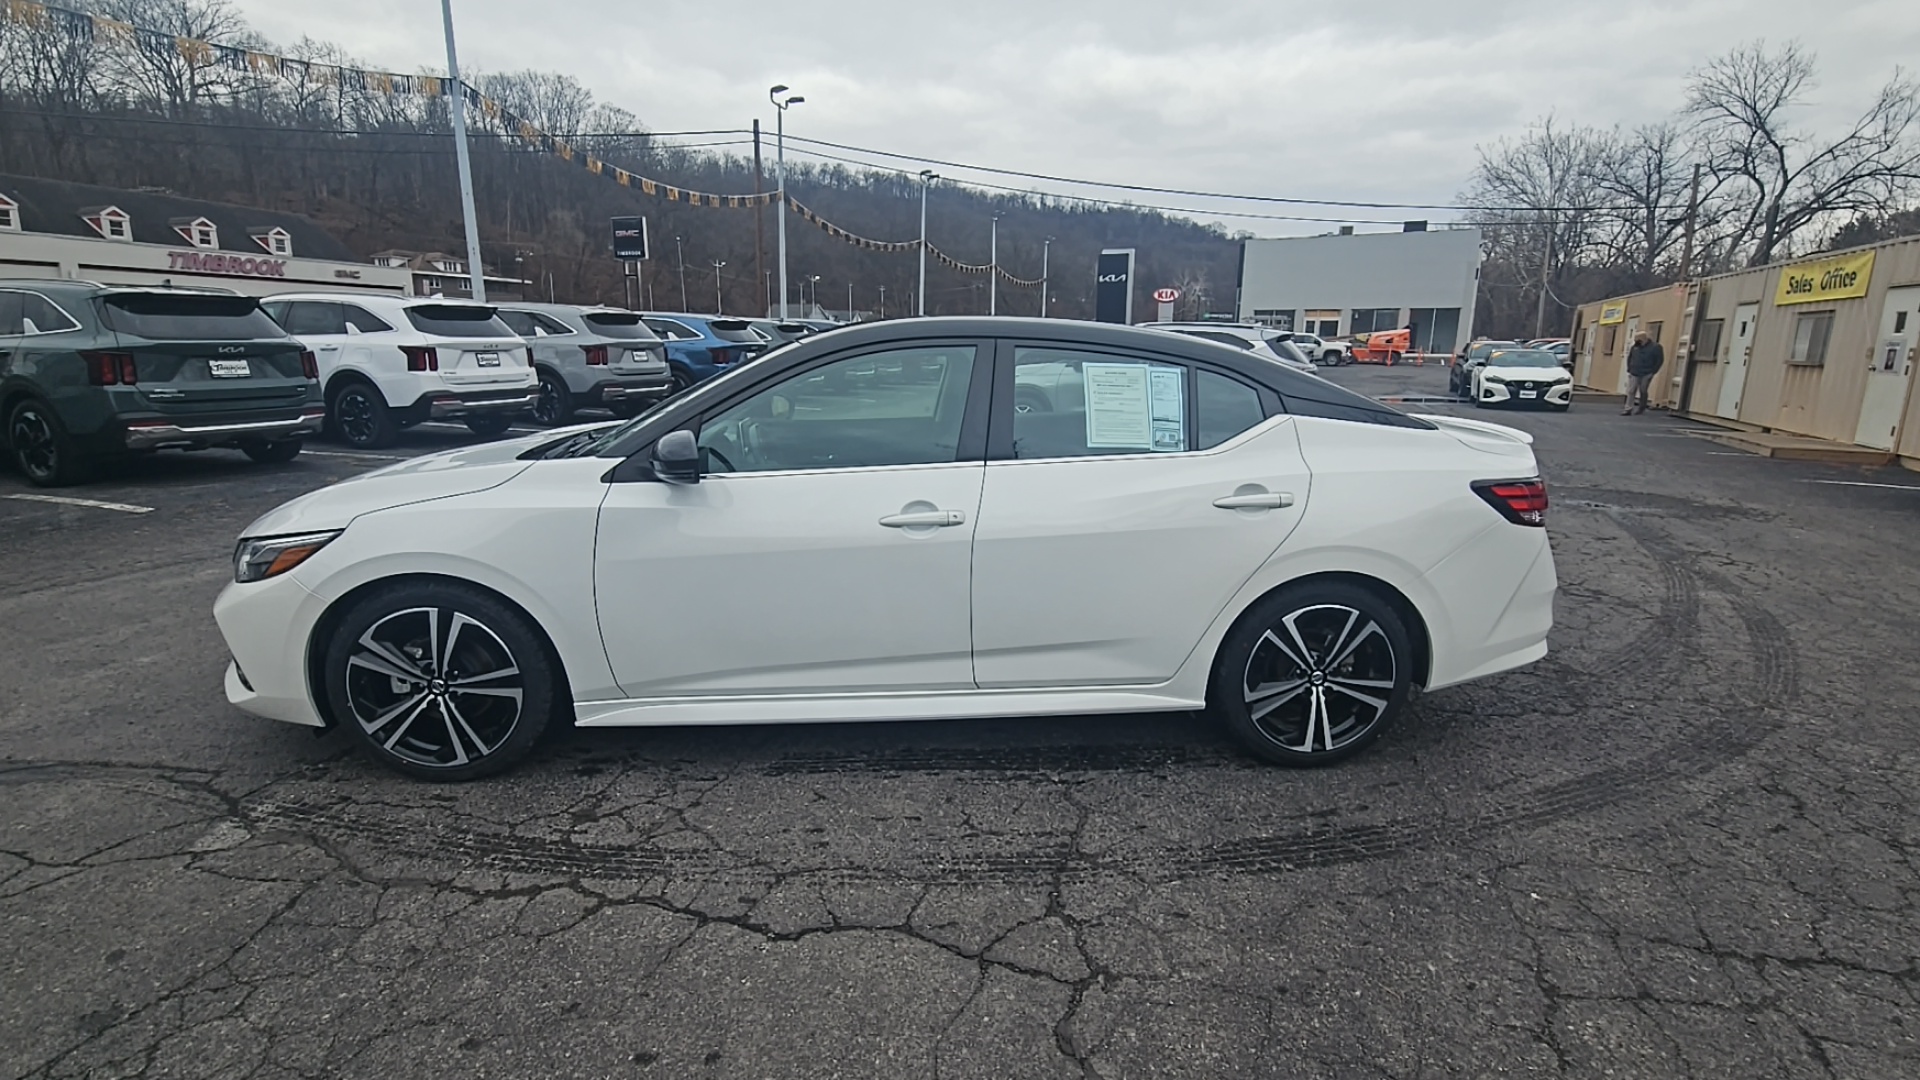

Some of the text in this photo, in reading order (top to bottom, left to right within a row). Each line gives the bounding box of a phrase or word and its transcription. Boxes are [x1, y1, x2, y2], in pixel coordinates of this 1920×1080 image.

[167, 251, 287, 276] TIMBROOK
[1099, 273, 1126, 282] KIA
[1785, 266, 1857, 295] Sales Office
[1157, 290, 1176, 299] KIA
